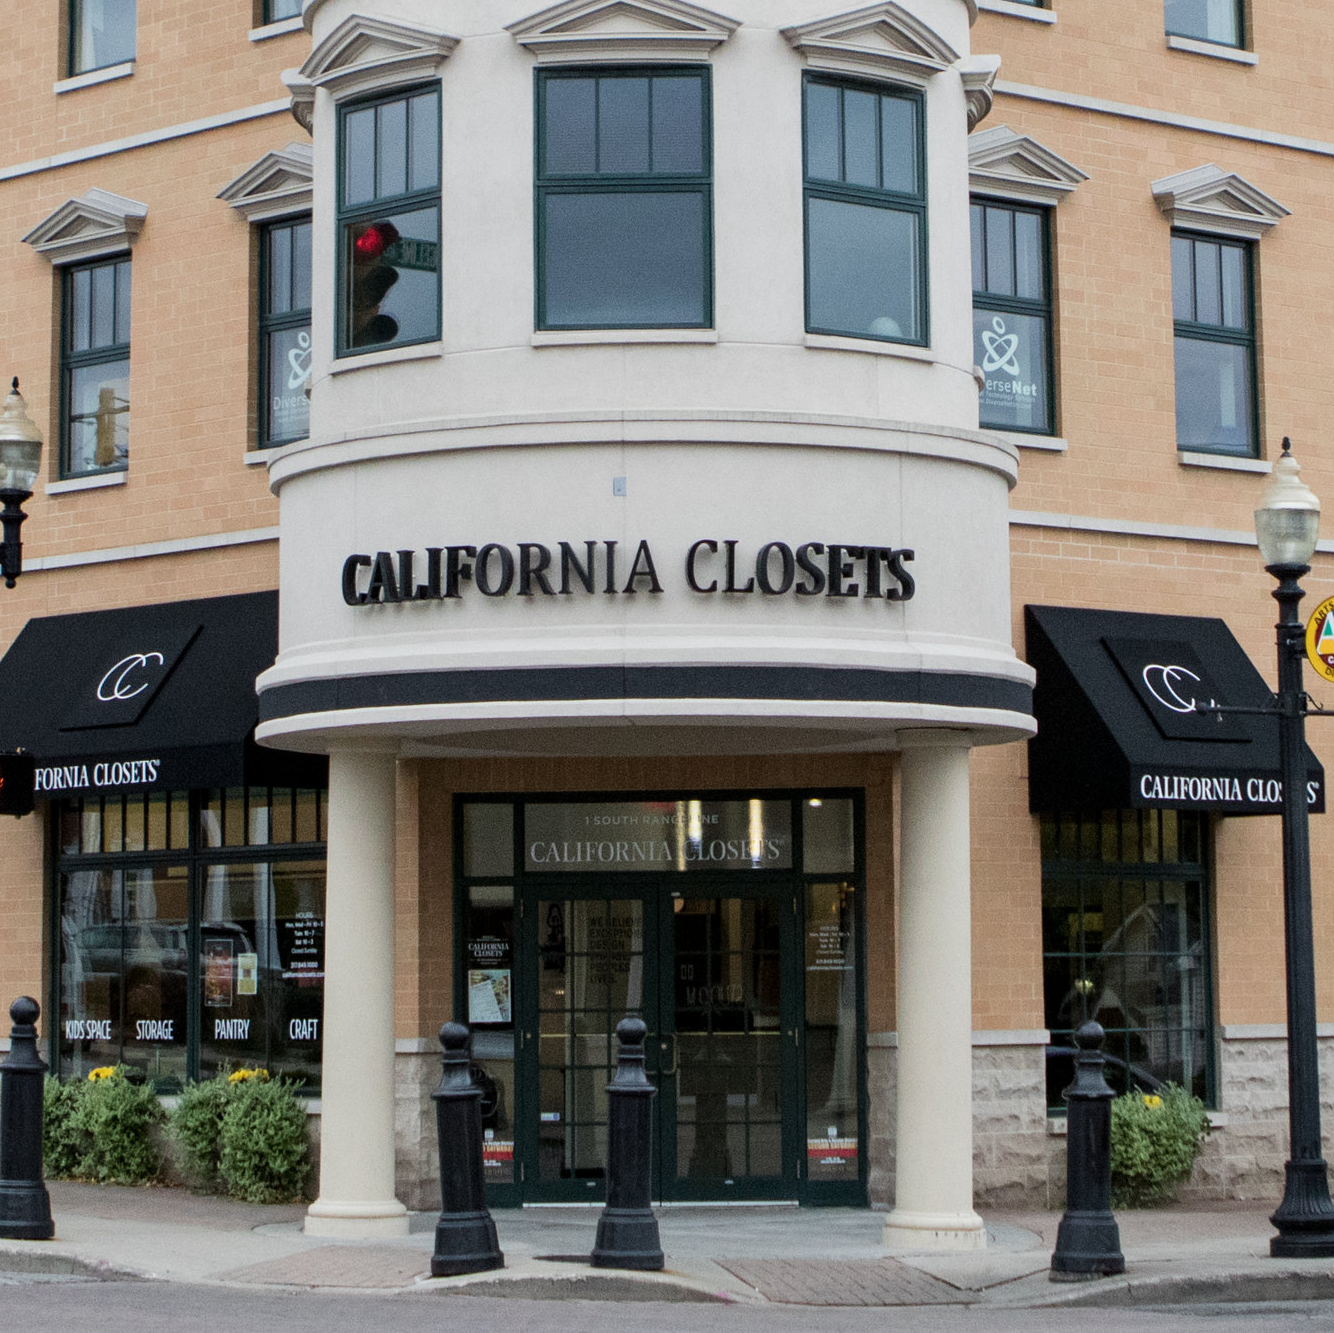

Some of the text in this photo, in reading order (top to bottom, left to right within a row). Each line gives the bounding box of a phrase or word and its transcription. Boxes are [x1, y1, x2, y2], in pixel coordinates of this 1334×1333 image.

[985, 379, 1038, 397] erseNet
[273, 395, 308, 410] Divers
[341, 539, 917, 607] CALIFORNIA CLOSETS
[1314, 601, 1334, 626] ARTS
[34, 765, 90, 791] FORNIA
[1140, 774, 1318, 804] CALIFORNIA CLOS
[593, 816, 638, 826] SOUTH
[530, 838, 780, 863] CALIFORNIA CLOSES
[468, 942, 509, 951] CALIFORNIA
[65, 1020, 112, 1040] KIDS SPACE
[135, 1019, 174, 1040] STORAGE
[214, 1019, 250, 1040] PANTRY
[289, 1019, 319, 1040] CRAFT
